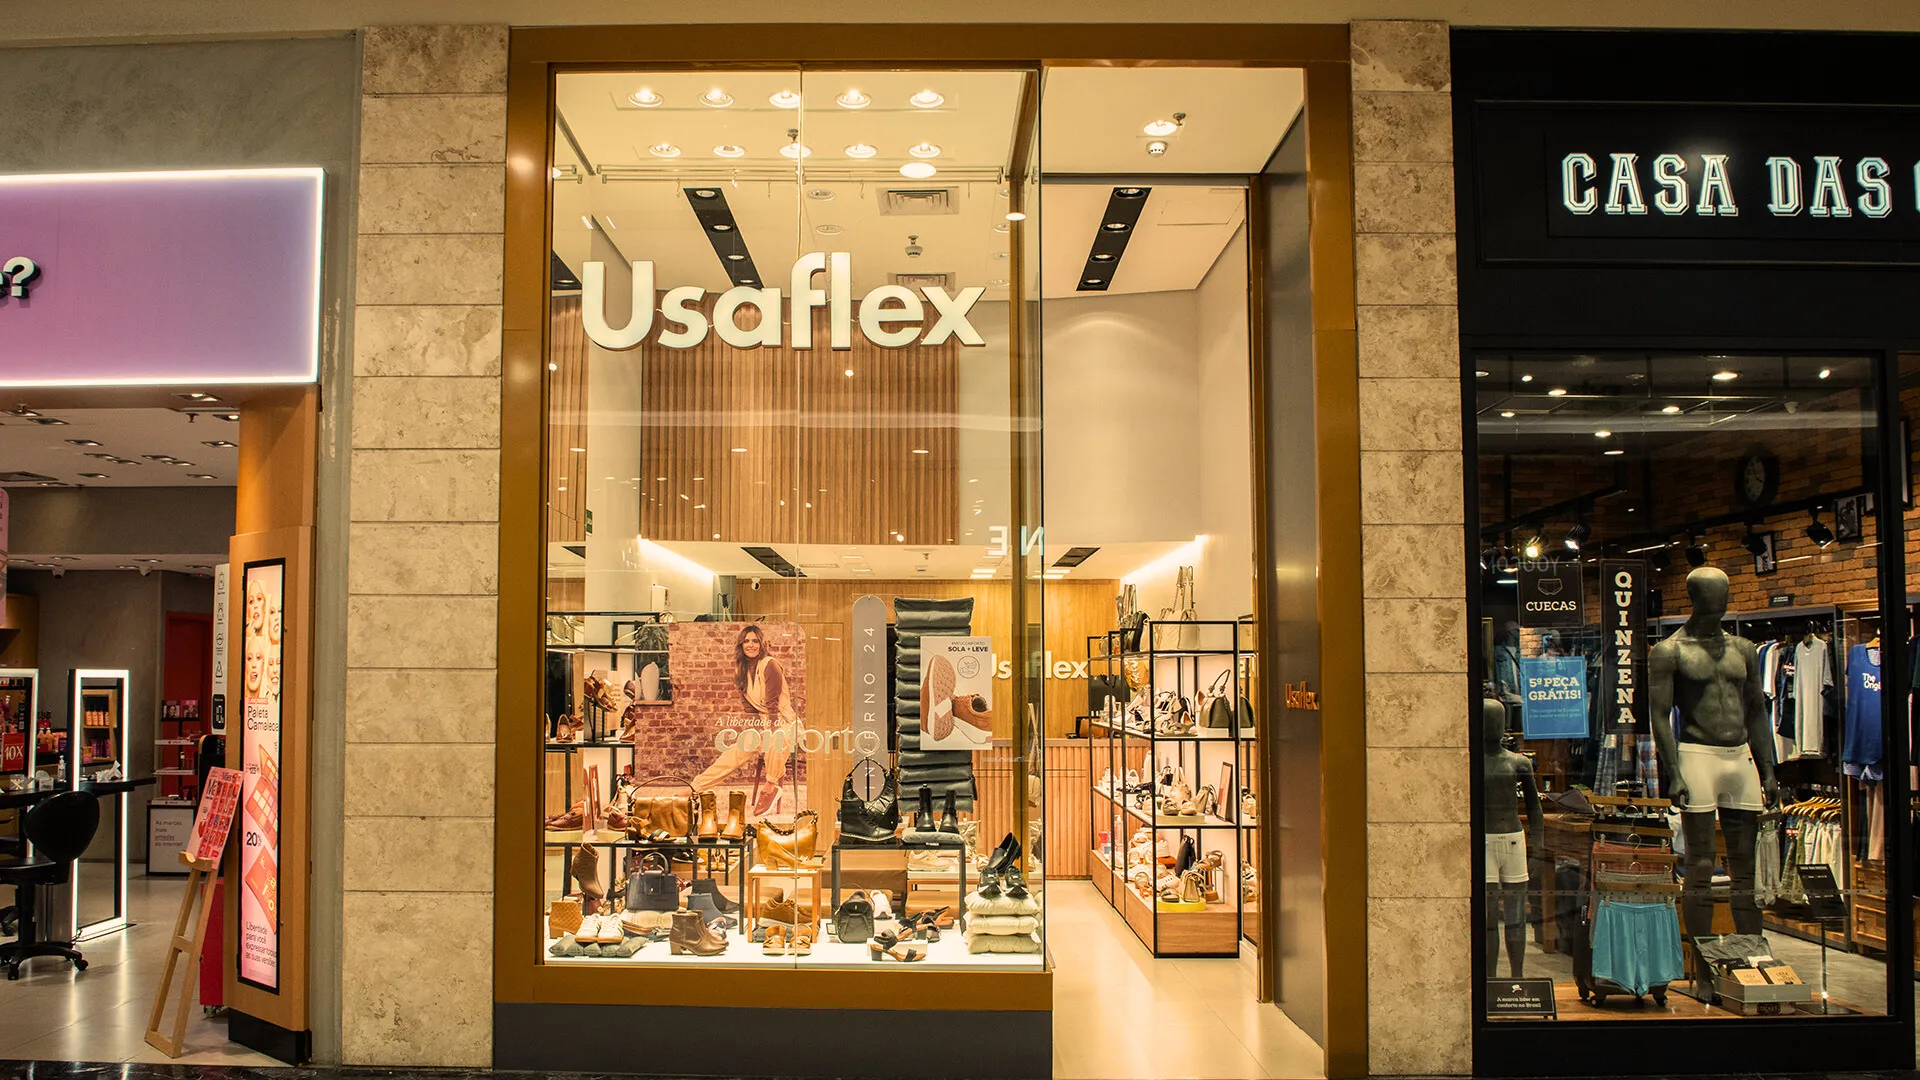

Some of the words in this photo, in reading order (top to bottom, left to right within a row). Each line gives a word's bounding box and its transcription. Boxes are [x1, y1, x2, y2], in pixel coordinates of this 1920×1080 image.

[1561, 153, 1739, 217] CASA
[1765, 156, 1893, 219] DAS
[581, 251, 986, 351] Usaflex
[1526, 601, 1576, 611] CUECAS
[864, 627, 876, 653] 24
[1614, 571, 1636, 723] QUINZENA
[1543, 676, 1580, 690] PEÇA
[1862, 672, 1876, 682] The
[1528, 688, 1582, 701] GRÁTIS!
[247, 705, 268, 718] Paleta
[715, 716, 723, 726] A
[726, 716, 771, 727] liberdade
[714, 719, 881, 755] conforto
[4, 745, 23, 760] 10X
[246, 831, 258, 847] 20
